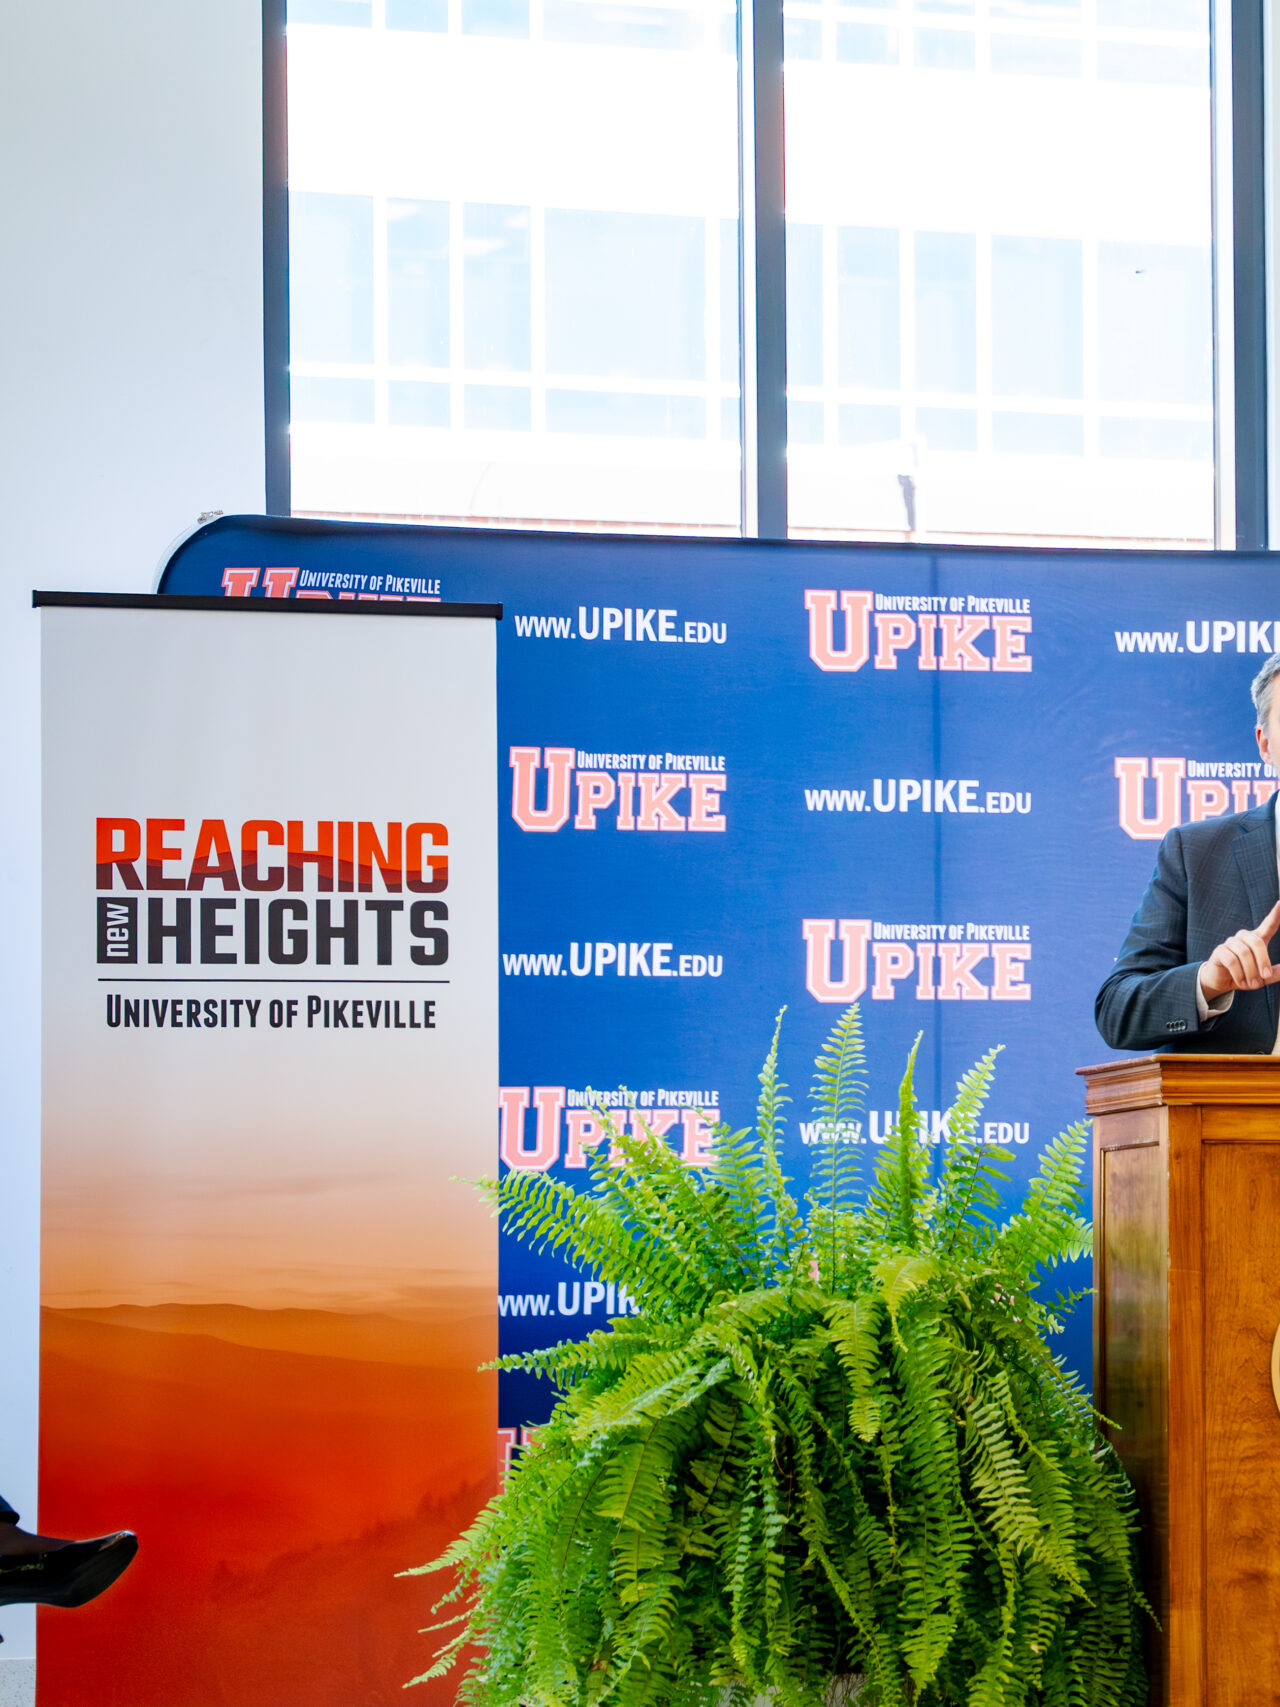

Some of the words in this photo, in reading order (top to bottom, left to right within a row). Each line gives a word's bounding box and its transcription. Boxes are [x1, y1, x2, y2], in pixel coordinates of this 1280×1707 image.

[299, 569, 368, 590] UNIVERSITY
[369, 575, 383, 591] OF
[385, 574, 441, 595] PIKEVILLE
[875, 593, 948, 612] UNIVERSITY
[949, 596, 966, 612] OF
[967, 595, 1031, 614] PIKEVILLE
[804, 589, 1033, 673] UPIKE
[577, 750, 646, 770] UNIVERSITY
[648, 754, 664, 770] OF
[665, 752, 726, 772] PIKEVILLE
[1187, 760, 1262, 778] UNIVERSITY
[509, 746, 727, 832] UPIKE
[1114, 757, 1280, 840] UPI
[96, 817, 449, 893] REACHING
[105, 902, 130, 958] new
[147, 897, 449, 966] HEIGHTS
[873, 922, 947, 940] UNIVERSITY
[948, 925, 964, 940] OF
[966, 922, 1030, 941] PIKEVILLE
[802, 919, 1032, 1003] UPIKE
[106, 994, 261, 1028] UNIVERSITY
[268, 998, 299, 1028] OF
[307, 995, 436, 1029] PIKEVILLE
[640, 1091, 656, 1107] OF
[657, 1088, 719, 1107] PIKEVILLE
